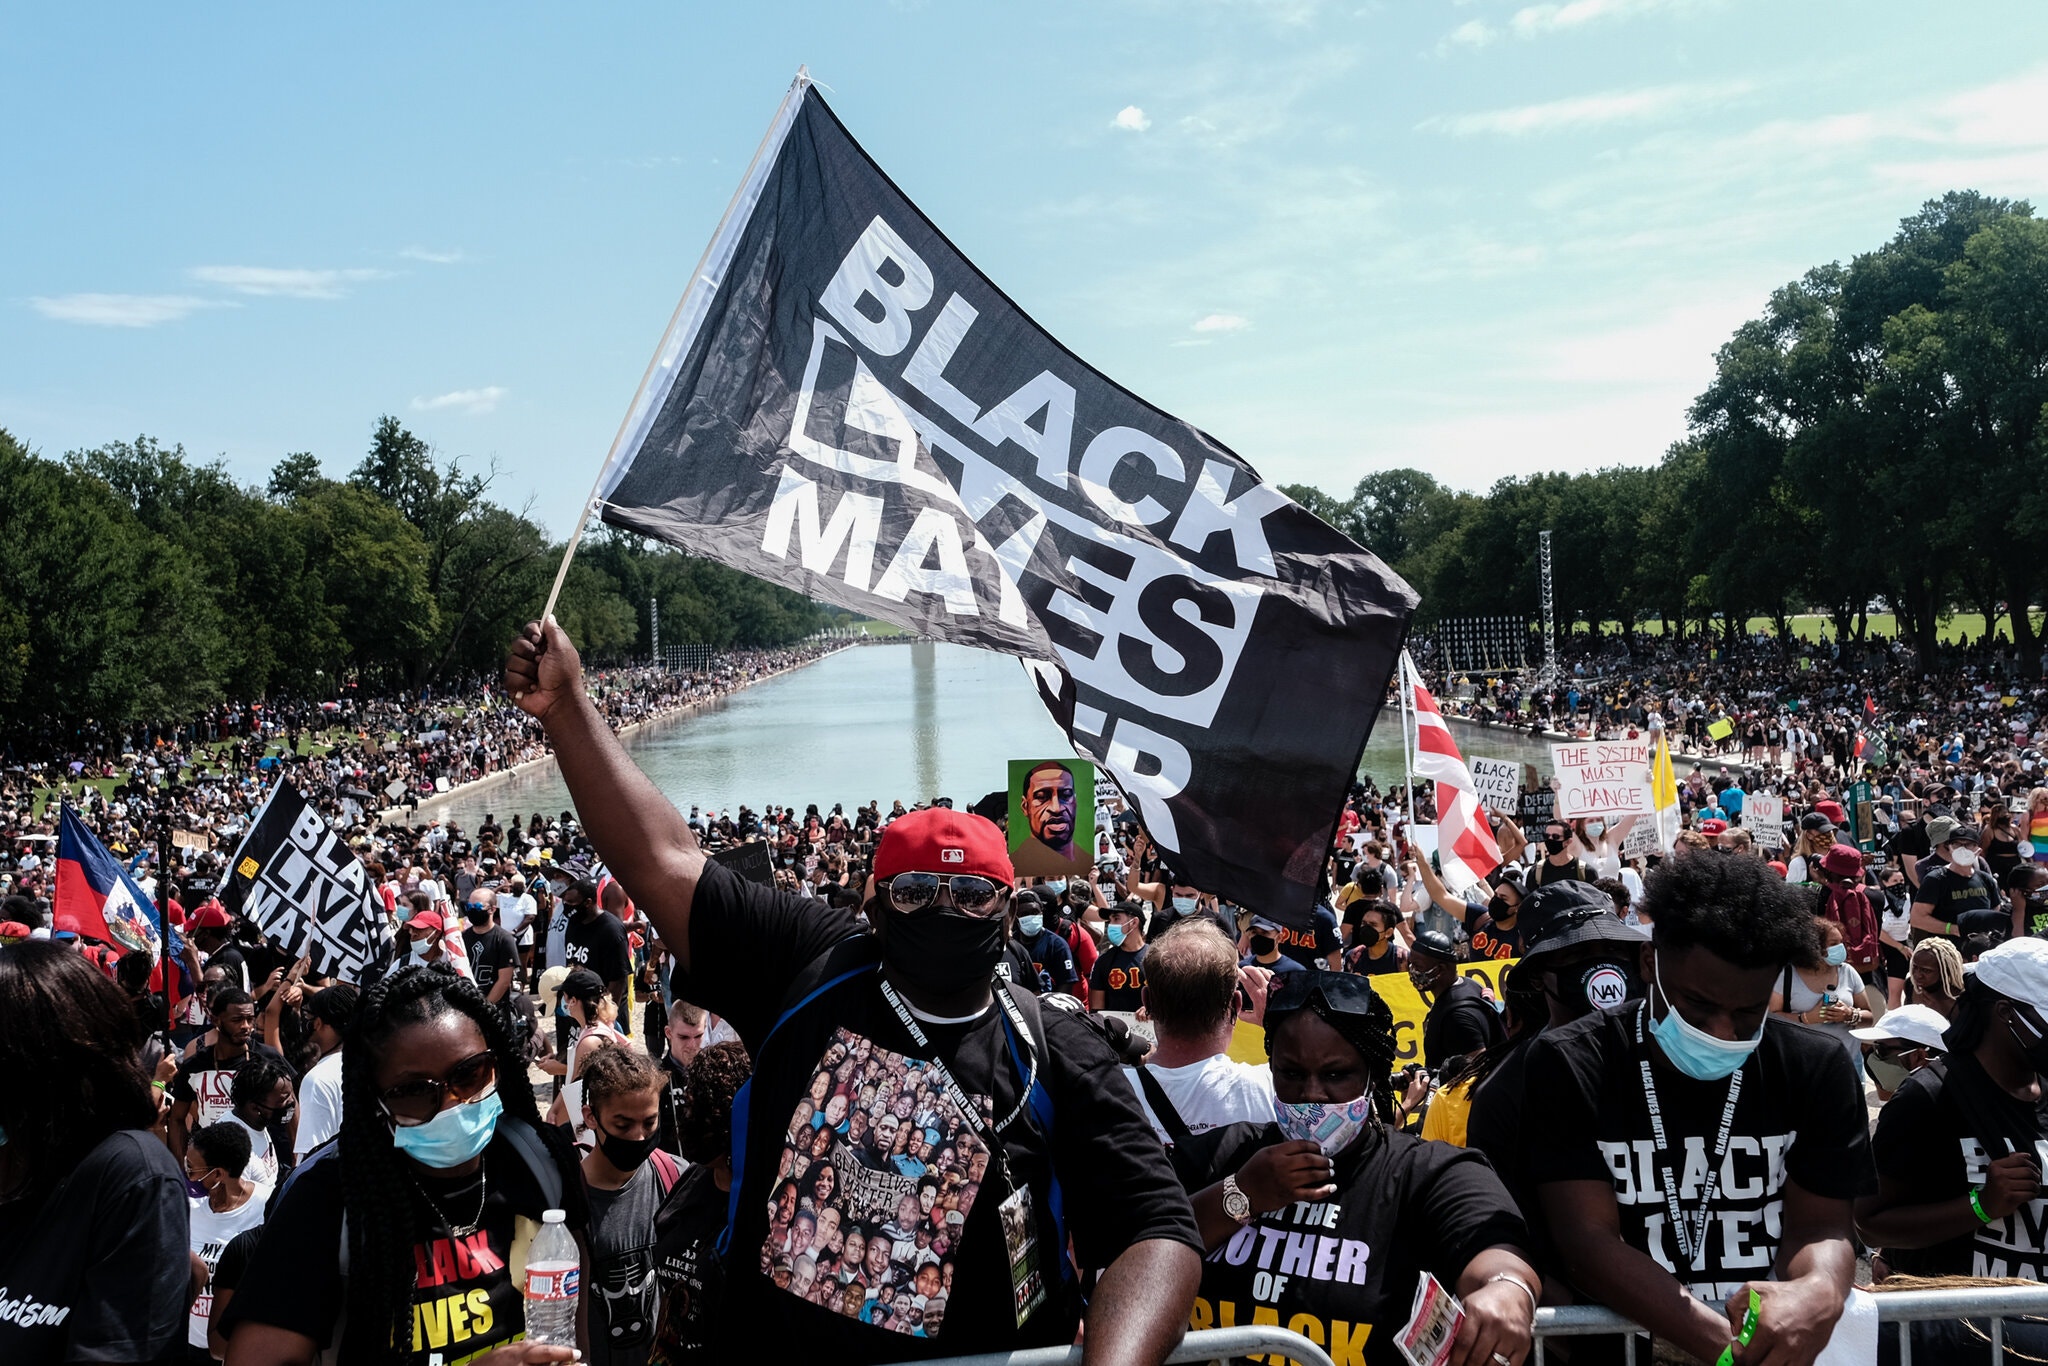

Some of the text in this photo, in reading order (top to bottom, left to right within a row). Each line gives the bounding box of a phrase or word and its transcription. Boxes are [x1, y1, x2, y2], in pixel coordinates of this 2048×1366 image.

[818, 214, 1296, 578] BLACK
[1556, 748, 1589, 764] THE
[1474, 761, 1515, 780] BLACK
[1581, 766, 1625, 783] MUST
[1474, 778, 1513, 793] LIVES
[1478, 794, 1515, 811] ATTER
[1525, 793, 1556, 807] DEFUN
[1568, 788, 1642, 809] CHANGE
[1753, 801, 1772, 816] NO
[242, 880, 363, 987] MATTE
[566, 942, 589, 964] 8:46
[1591, 984, 1623, 1000] NAN
[895, 1004, 912, 1026] LIVES
[907, 1022, 929, 1047] BLACK
[950, 1084, 968, 1108] LIVES
[1640, 1060, 1667, 1150] BLACK LIVES MATTER
[964, 1105, 985, 1132] BLACK
[1714, 1069, 1743, 1156] BLACK LIVES MATTER
[835, 1153, 872, 1184] BLACK
[1293, 1201, 1341, 1229] THE
[1661, 1167, 1688, 1255] BLACK LIVES MATTER
[1692, 1171, 1717, 1257] BLACK LIVES MATTER
[199, 1243, 223, 1259] MY
[413, 1229, 504, 1289] LACK
[1206, 1224, 1370, 1285] OTHER
[1252, 1271, 1289, 1303] OF
[411, 1288, 494, 1352] IVES
